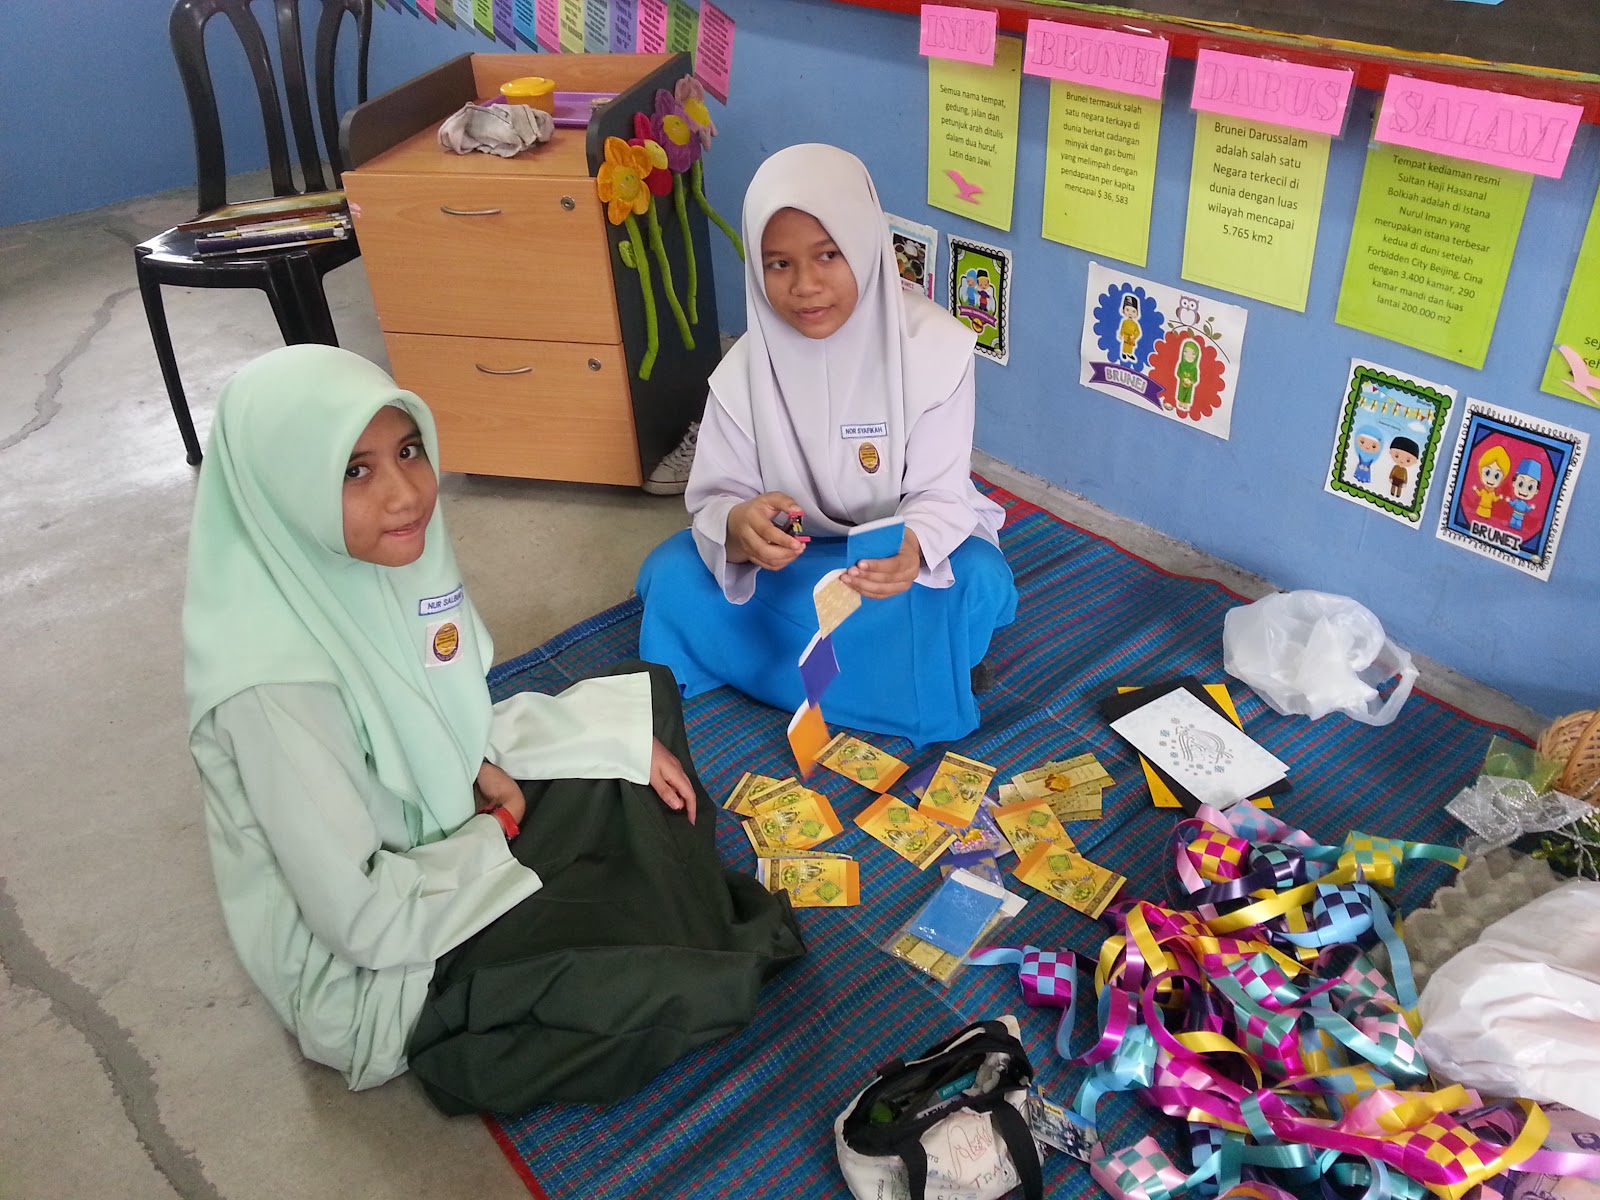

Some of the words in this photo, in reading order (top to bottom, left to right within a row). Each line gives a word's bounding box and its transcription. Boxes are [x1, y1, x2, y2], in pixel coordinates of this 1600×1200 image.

[925, 14, 991, 55] INFO
[1031, 30, 1161, 88] BRUNEI
[940, 85, 960, 96] Semua
[962, 92, 979, 101] nama
[981, 95, 1006, 108] tempat,
[1067, 92, 1087, 101] Brunei
[1090, 98, 1122, 110] termasuk
[1124, 104, 1141, 114] salah
[1200, 60, 1343, 121] DARUS
[971, 107, 986, 118] jalan
[988, 112, 999, 122] dan
[1065, 108, 1079, 117] satu
[1081, 112, 1104, 122] negara
[1106, 116, 1131, 129] terkaya
[1134, 122, 1140, 130] di
[1389, 90, 1568, 164] SALAM
[941, 118, 968, 129] petunjuk
[969, 124, 982, 133] arah
[984, 127, 1003, 139] ditulis
[1063, 123, 1081, 133] dunia
[1083, 127, 1105, 138] berkat
[1106, 132, 1139, 146] cadangan
[1215, 122, 1246, 136] Brunei
[1249, 128, 1308, 149] Darussalam
[946, 132, 964, 143] dalam
[966, 138, 976, 147] dua
[978, 141, 996, 154] huruf,
[949, 149, 963, 159] Latin
[965, 153, 976, 162] dan
[1065, 139, 1089, 149] minyak
[1090, 144, 1103, 153] dan
[1104, 148, 1116, 156] gas
[1118, 149, 1135, 160] bumi
[1216, 144, 1247, 158] adalah
[1251, 151, 1276, 164] salah
[1279, 157, 1301, 168] satu
[1061, 153, 1076, 163] yang
[1078, 156, 1110, 169] melimpah
[1112, 164, 1138, 176] dengan
[1214, 163, 1247, 178] Negara
[1250, 171, 1287, 187] terkecil
[1290, 179, 1299, 189] di
[1393, 155, 1426, 169] Tempat
[1428, 162, 1471, 180] kediaman
[1474, 175, 1500, 186] resmi
[1061, 168, 1099, 182] pendapatan
[1114, 180, 1135, 191] kapita
[1398, 173, 1425, 186] Sultan
[1428, 180, 1444, 192] Haji
[1447, 186, 1487, 200] Hassanal
[1065, 183, 1096, 196] mencapai
[1098, 190, 1101, 198] $
[1116, 195, 1128, 204] 583
[1210, 182, 1235, 196] dunia
[1238, 188, 1274, 205] dengan
[1278, 196, 1298, 210] luas
[1388, 187, 1418, 201] Bolkiah
[1421, 197, 1450, 209] adalah
[1453, 203, 1460, 211] di
[1463, 205, 1490, 219] Istana
[1208, 203, 1243, 218] wilayah
[1246, 212, 1294, 229] mencapai
[1400, 207, 1423, 219] Nurul
[1426, 213, 1447, 225] Iman
[1450, 220, 1470, 233] yang
[1223, 224, 1249, 239] 5.765
[1252, 231, 1273, 245] km2
[1375, 217, 1422, 235] merupakan
[1424, 230, 1450, 242] istana
[1453, 237, 1490, 253] terbesar
[1383, 234, 1408, 248] kedua
[1411, 242, 1418, 250] di
[1420, 245, 1439, 256] duni
[1442, 251, 1473, 265] setelah
[1368, 246, 1409, 263] Forbidden
[1412, 258, 1428, 270] City
[1430, 263, 1460, 279] Beijing,
[1464, 272, 1483, 284] Cina
[1369, 262, 1398, 276] dengan
[1401, 271, 1424, 284] 3.400
[1427, 277, 1455, 294] kamar,
[1458, 287, 1475, 299] 290
[1372, 278, 1398, 292] kamar
[1400, 287, 1425, 300] mandi
[1428, 296, 1443, 306] dan
[1446, 299, 1463, 311] luas
[1377, 295, 1400, 308] lantai
[1402, 303, 1435, 319] 200.000
[1438, 315, 1451, 324] m2
[1105, 367, 1148, 392] BRUNEI
[1471, 521, 1522, 552] BRUNEI
[428, 601, 441, 609] NUR
